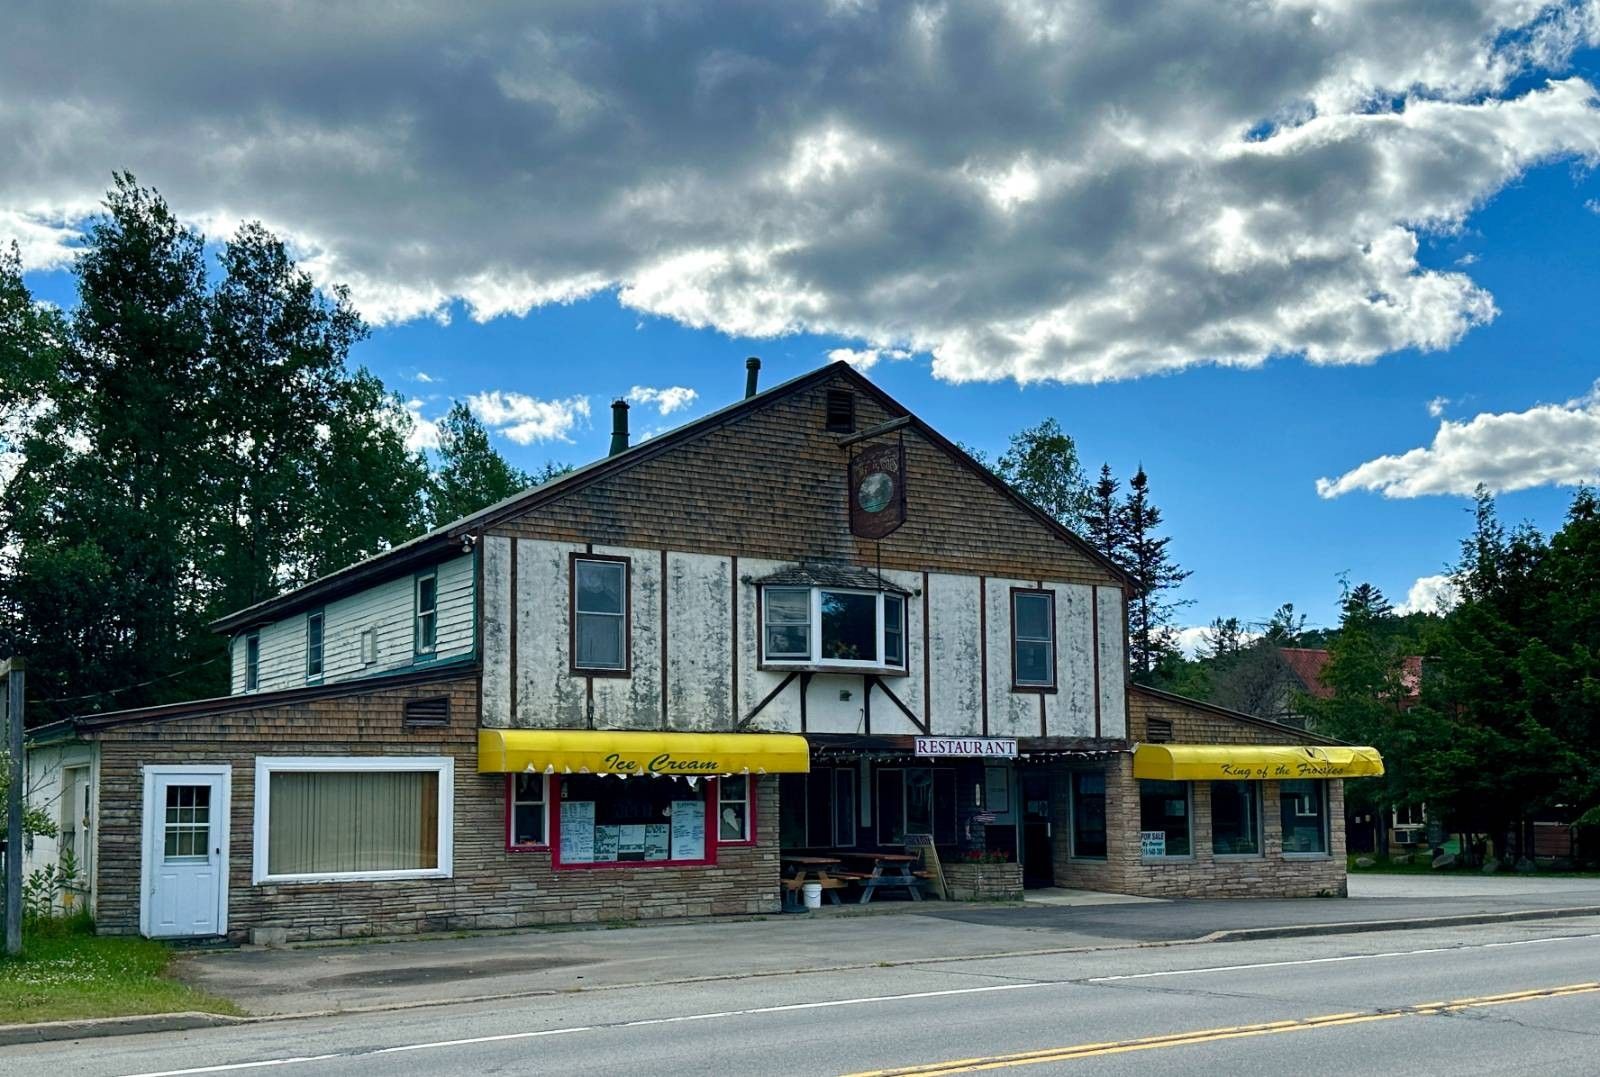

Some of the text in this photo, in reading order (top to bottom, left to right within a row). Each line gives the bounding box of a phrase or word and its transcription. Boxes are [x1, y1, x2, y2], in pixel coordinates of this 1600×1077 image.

[918, 740, 1015, 755] RESTAURANT
[605, 753, 719, 772] Ice Cream
[1221, 763, 1252, 778] King
[1257, 766, 1268, 778] of
[1275, 765, 1291, 775] the
[1141, 832, 1164, 840] FOR SALE
